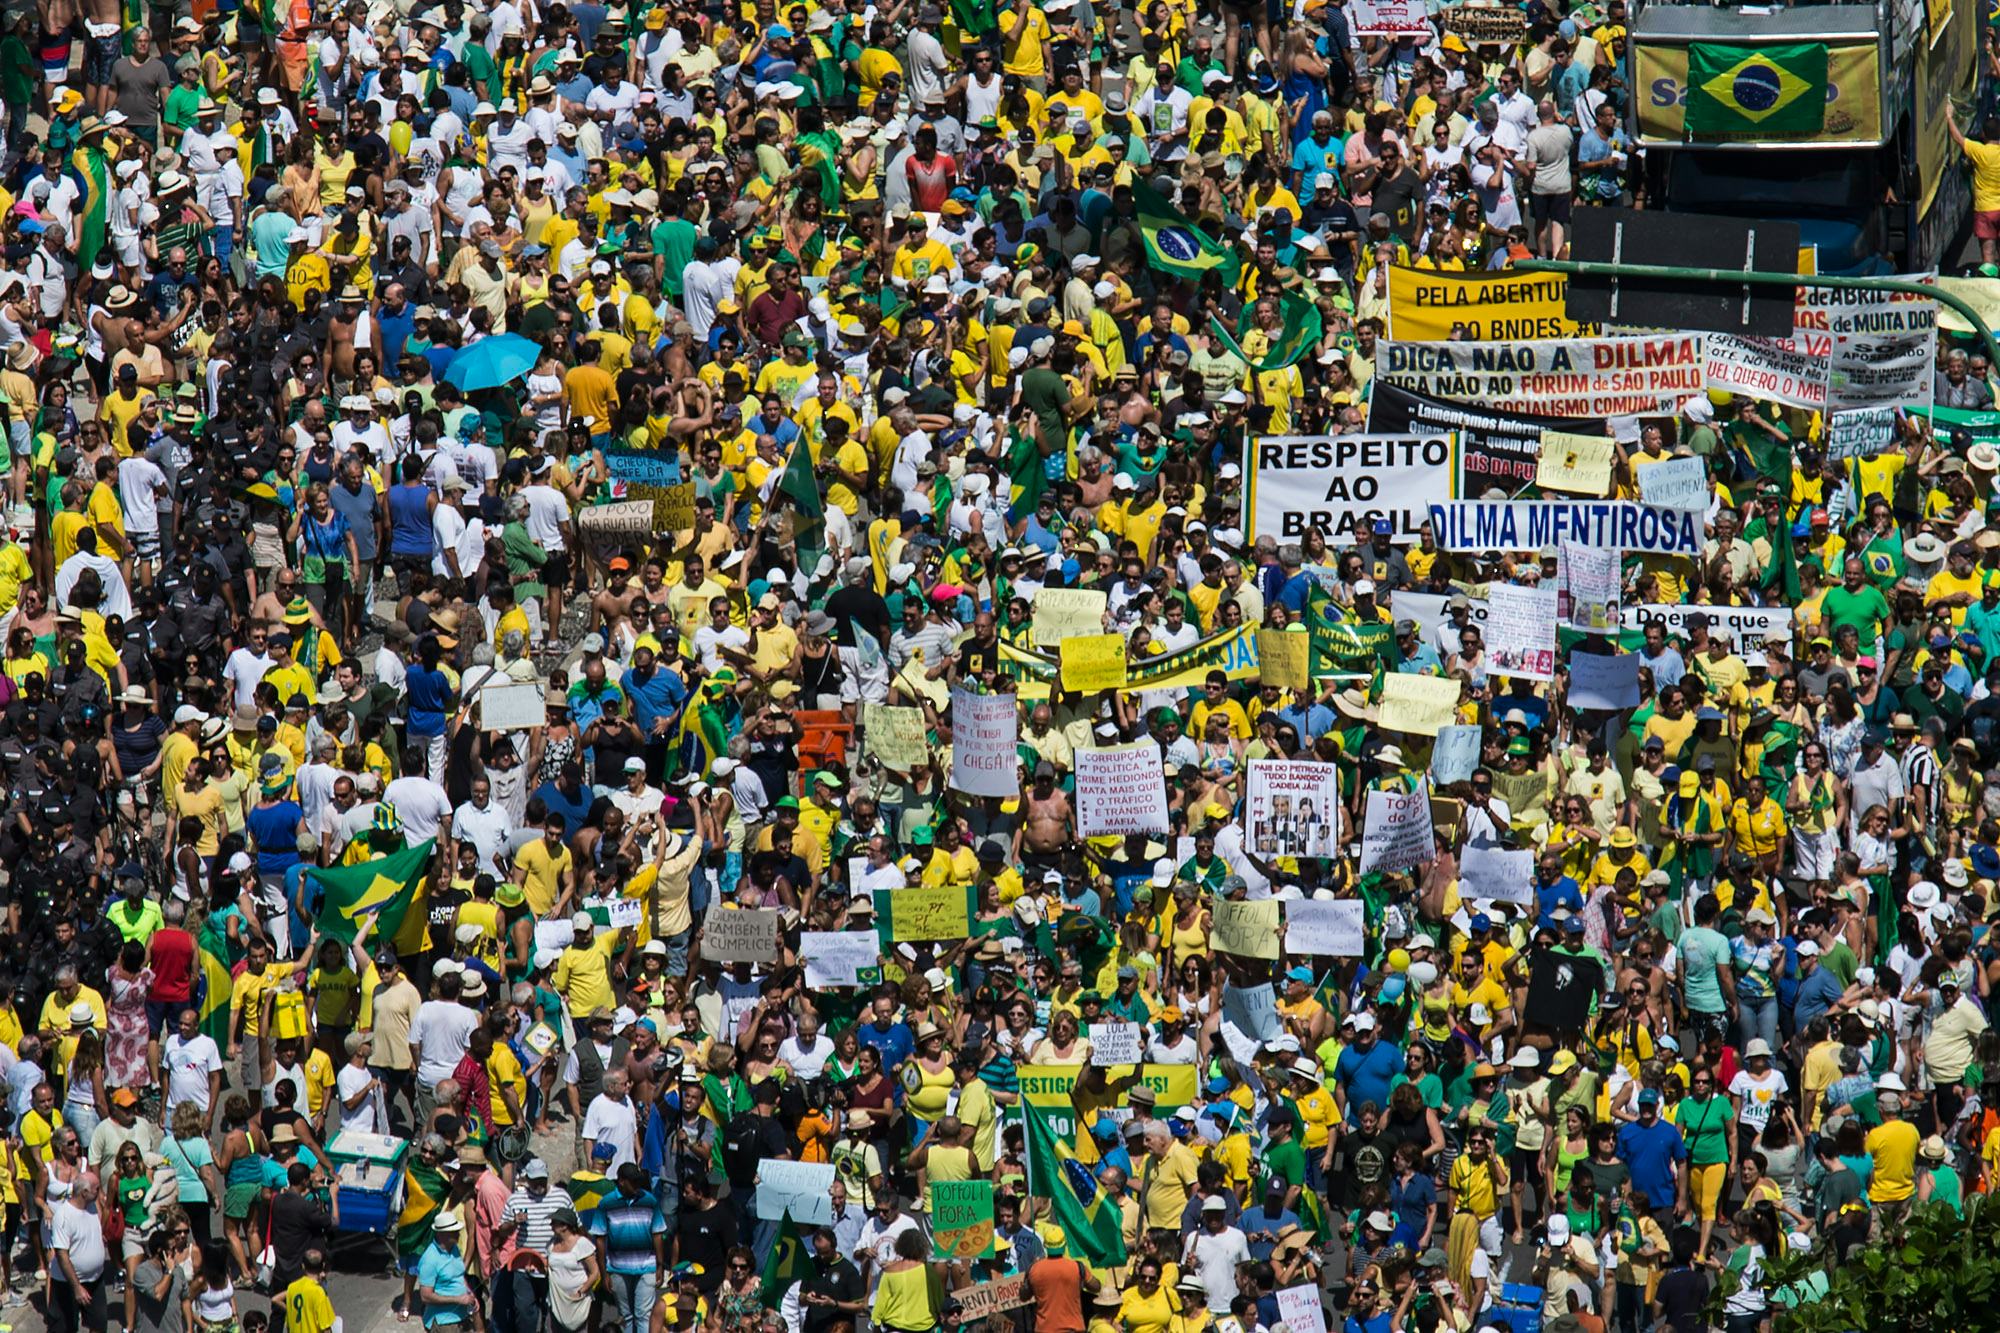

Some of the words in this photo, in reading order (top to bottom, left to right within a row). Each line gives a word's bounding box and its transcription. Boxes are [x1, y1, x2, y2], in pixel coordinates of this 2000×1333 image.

[291, 269, 306, 284] 10
[1416, 286, 1469, 306] PELA
[1808, 287, 1828, 305] de
[1830, 287, 1886, 305] ABRIL
[1833, 316, 1852, 333] de
[1853, 311, 1905, 332] MUITA
[1908, 309, 1936, 330] DOR
[1389, 346, 1456, 372] DIGA
[1473, 343, 1536, 372] NÃO
[1551, 346, 1573, 371] A
[1594, 338, 1703, 369] DILMA!
[1743, 355, 1762, 366] NO
[1782, 352, 1806, 365] POR
[1436, 372, 1481, 395] NÃO
[1487, 376, 1513, 395] AO
[1520, 372, 1588, 395] FÓRUM
[1593, 377, 1609, 391] de
[1612, 369, 1644, 391] SÃO
[1650, 368, 1701, 390] PAULO
[1733, 366, 1777, 391] QUERO
[1782, 378, 1793, 395] O
[1493, 396, 1589, 416] SOCIALISMO
[1594, 393, 1658, 413] COMUNA
[1417, 403, 1496, 431] Lamentamos
[1259, 440, 1449, 469] RESPEITO
[1464, 450, 1489, 473] AÍS
[1490, 457, 1511, 475] DA
[1513, 460, 1537, 480] PU
[1325, 475, 1378, 502] AO
[607, 502, 649, 515] POVO
[582, 519, 600, 530] NA
[603, 518, 627, 530] RUA
[629, 518, 651, 530] TEM
[1431, 504, 1518, 548] DILMA
[1529, 504, 1698, 552] MENTIROSA
[1637, 609, 1720, 626] Doea
[1729, 614, 1769, 632] que
[1085, 749, 1149, 762] CORRUPÇÃO
[1076, 774, 1105, 784] CRIME
[1109, 770, 1163, 783] HEDIONDO
[1275, 764, 1288, 772] DO
[1290, 765, 1332, 775] PETROLÃO
[1269, 782, 1300, 790] CADEIA
[1289, 774, 1325, 782] BANDIDO
[1080, 786, 1106, 794] MATA
[1110, 786, 1135, 794] MAIS
[1138, 782, 1159, 792] QUE
[1097, 798, 1104, 806] O
[1109, 794, 1152, 805] TRÁFICO
[1095, 808, 1101, 816] E
[1388, 812, 1406, 823] do
[611, 901, 639, 914] FORA
[712, 909, 745, 922] DILMA
[708, 921, 760, 936] TAMBÉM
[767, 921, 774, 936] É
[1219, 925, 1270, 949] FORA
[1106, 1024, 1128, 1034] LULA
[1018, 1077, 1075, 1094] ESTIGA
[933, 1184, 983, 1201] TOFFOLI
[939, 1206, 977, 1224] FORA
[293, 1294, 303, 1323] 9
